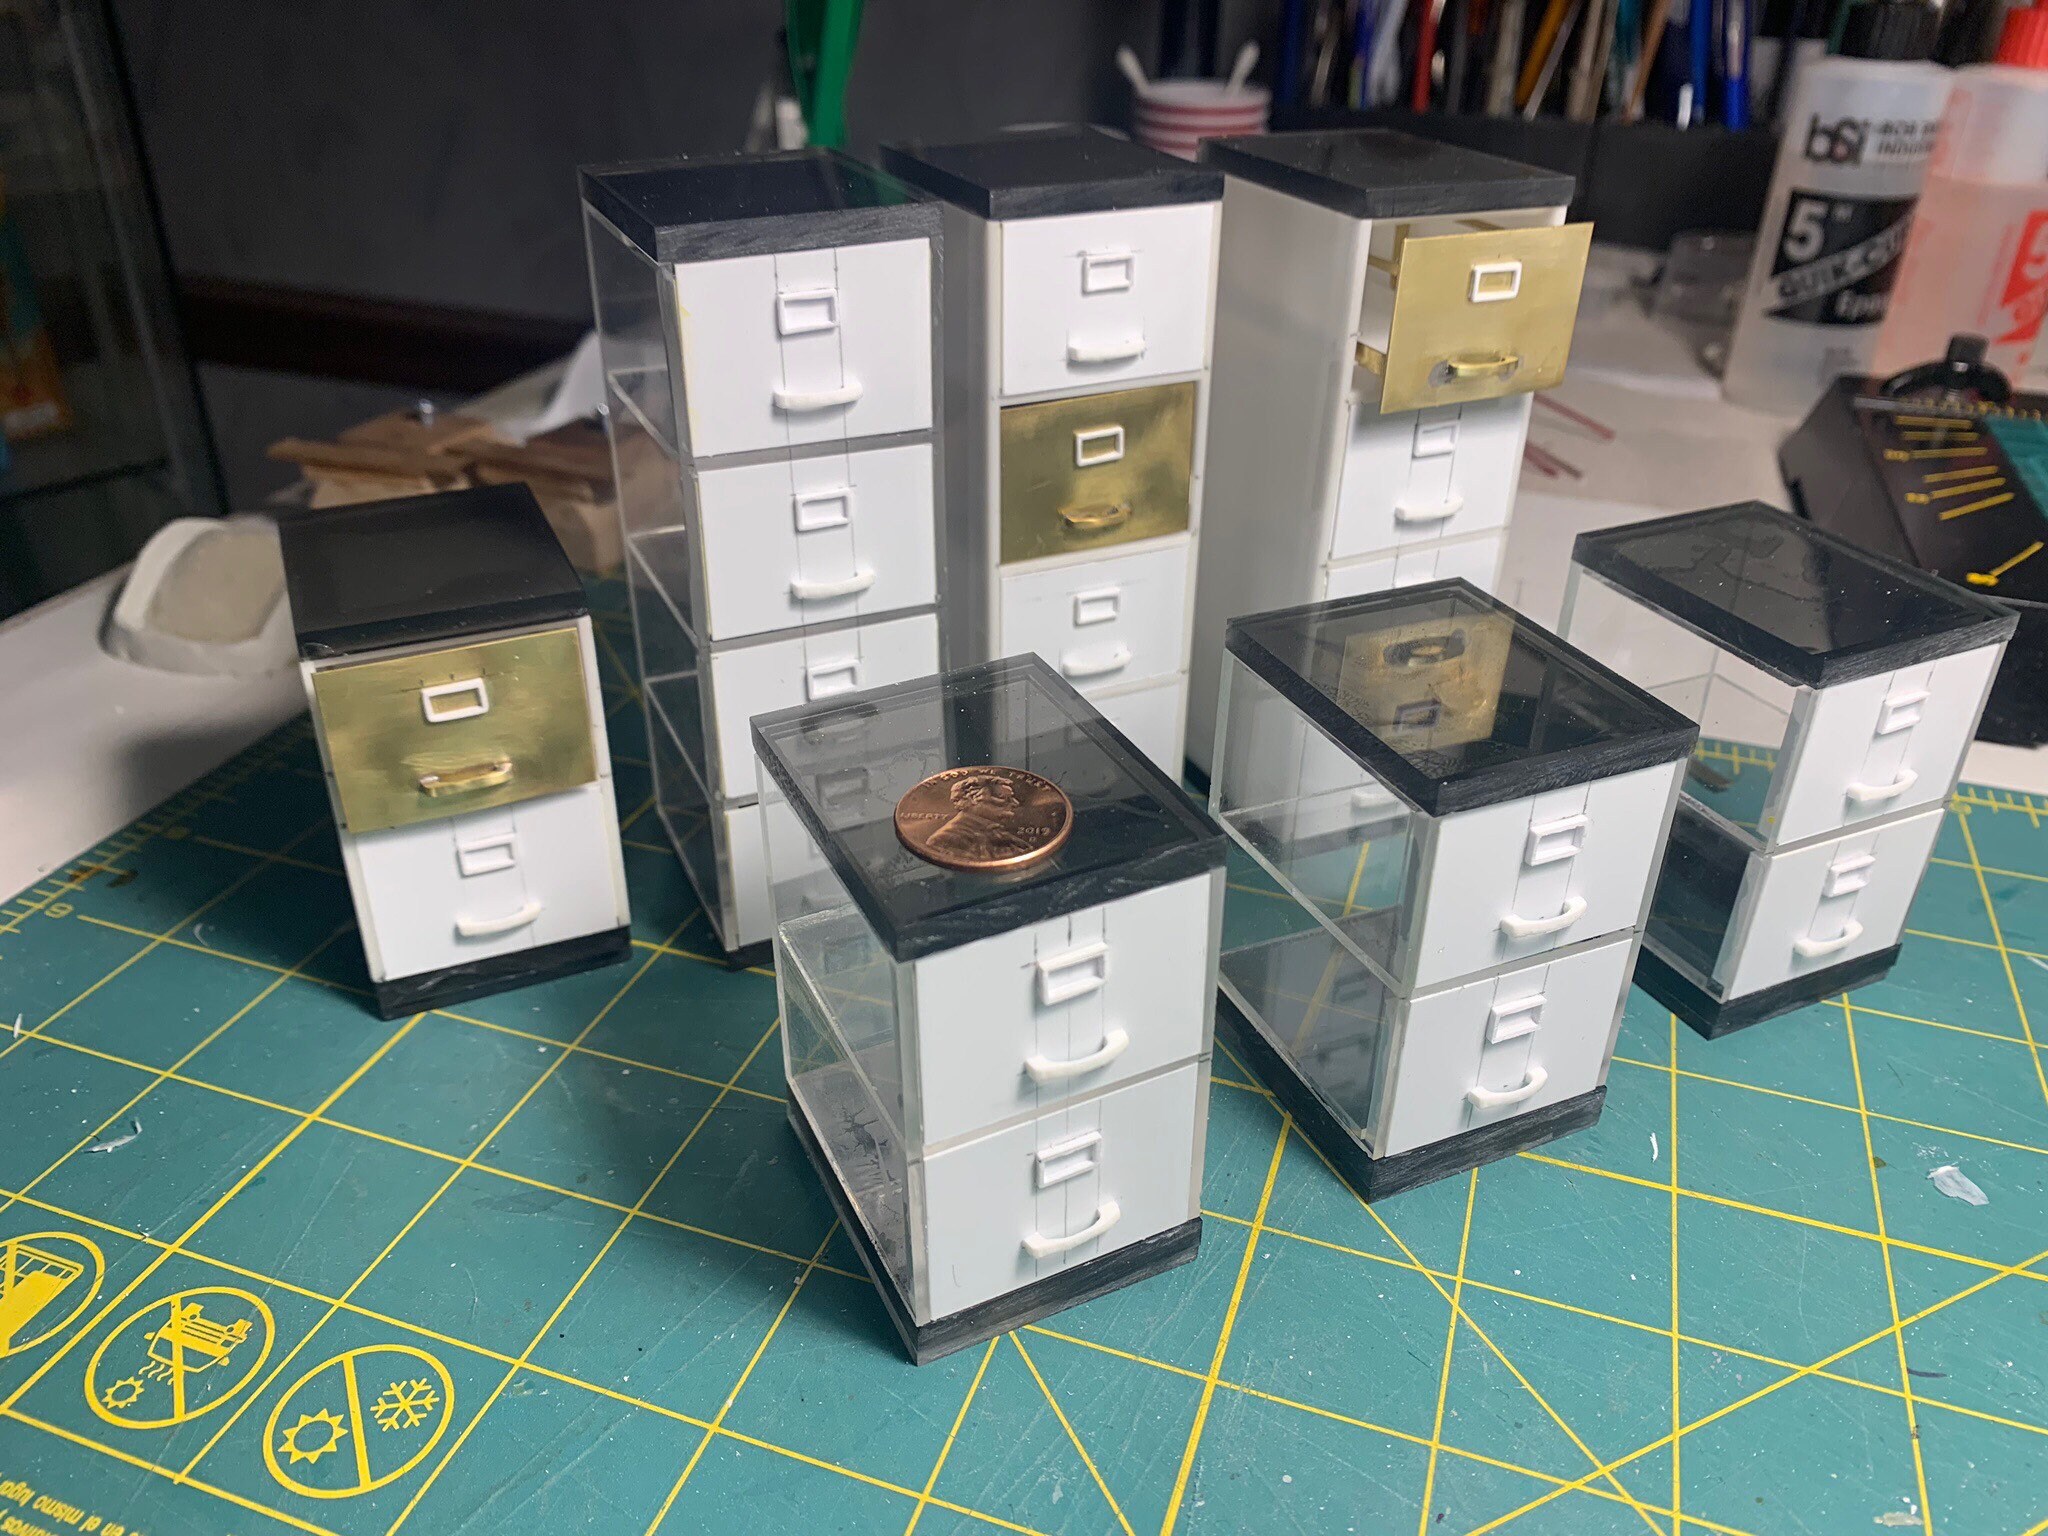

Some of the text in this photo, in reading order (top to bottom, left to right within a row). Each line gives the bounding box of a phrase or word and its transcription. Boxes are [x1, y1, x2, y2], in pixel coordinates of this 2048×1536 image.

[1784, 200, 1828, 263] 5
[899, 811, 950, 821] LIBERTY
[1016, 826, 1051, 837] 2019
[32, 1495, 85, 1525] mismo
